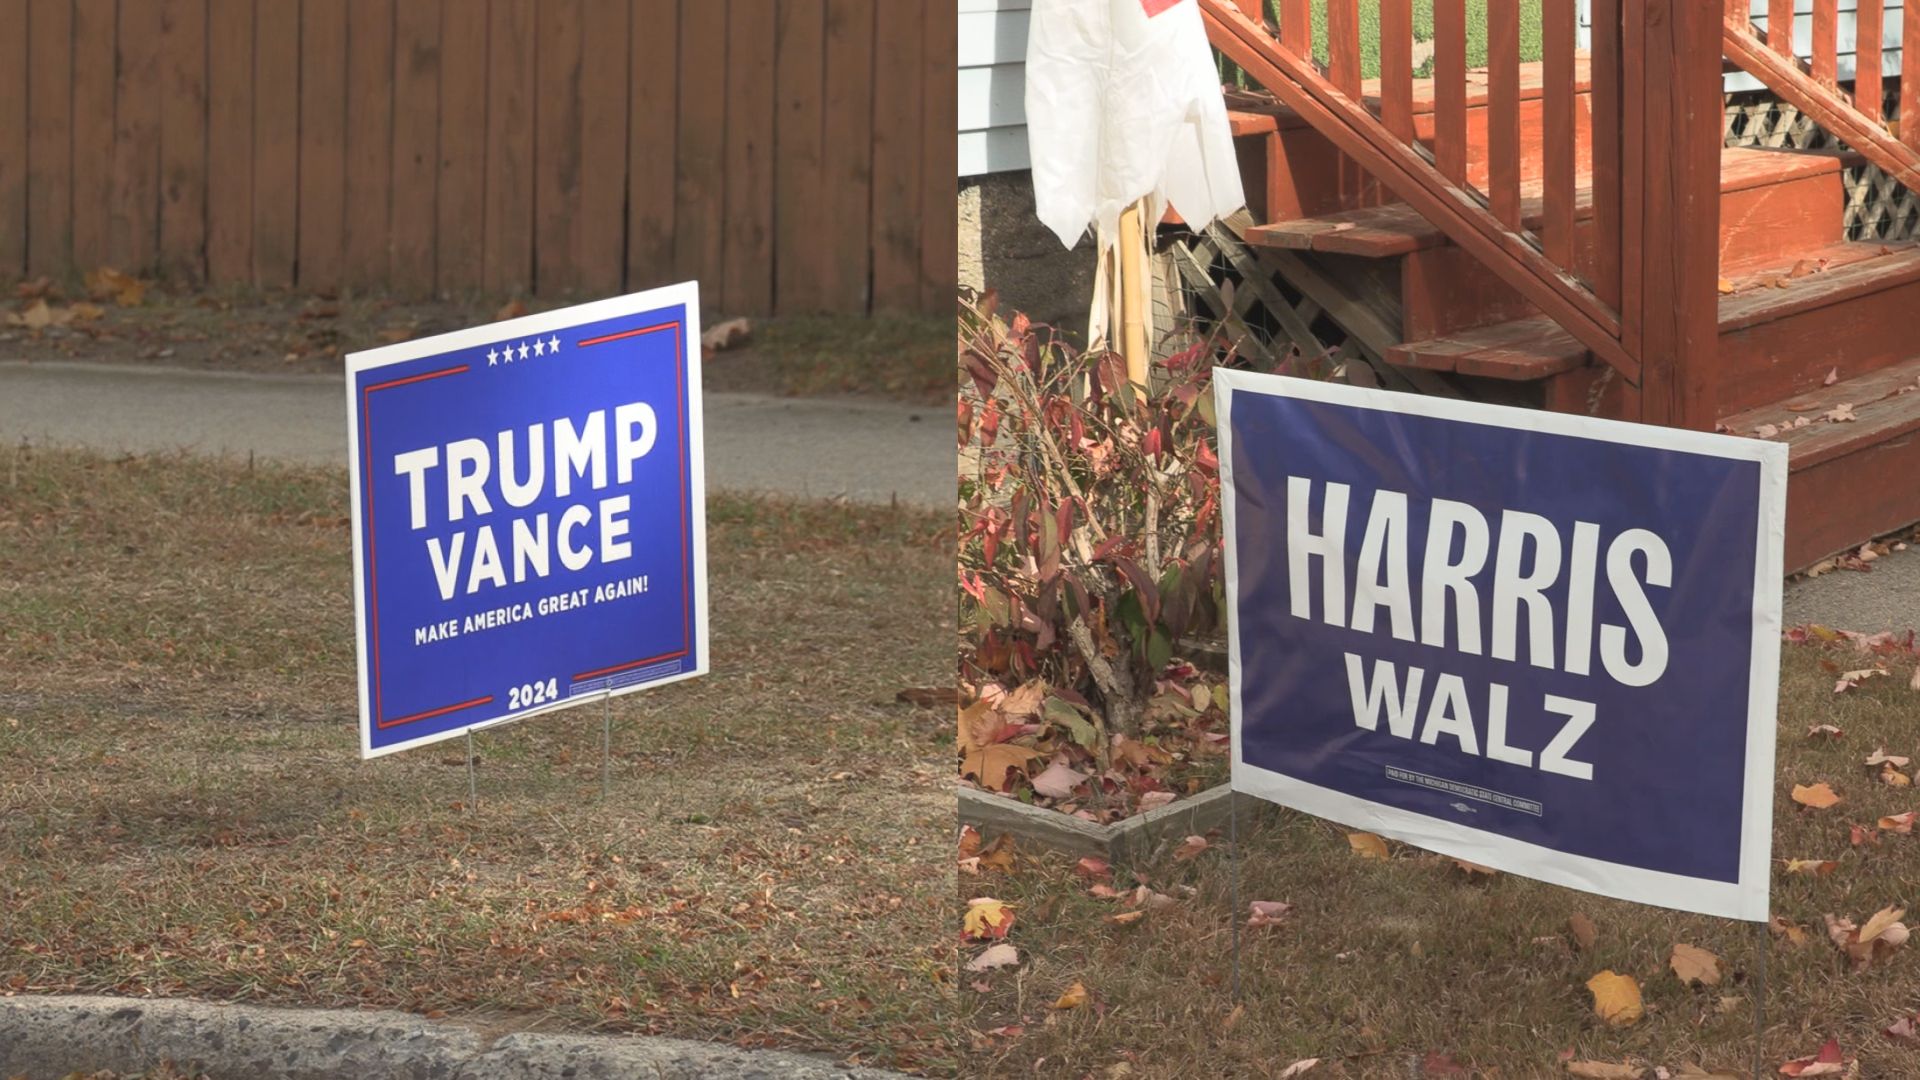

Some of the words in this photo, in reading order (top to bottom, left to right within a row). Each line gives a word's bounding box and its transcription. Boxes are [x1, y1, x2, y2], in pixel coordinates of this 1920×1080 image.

[394, 401, 657, 530] TRUMP
[426, 494, 632, 601] VANCE
[1287, 475, 1672, 687] HARRIS
[415, 618, 458, 645] MAKE
[463, 603, 533, 634] AMERICA
[538, 588, 589, 616] GREAT
[595, 575, 649, 604] AGAIN!
[508, 679, 558, 710] 2024
[1345, 652, 1597, 780] WALZ
[1387, 768, 1398, 777] PAID
[1398, 771, 1408, 780] FOR
[1409, 773, 1415, 782] BY
[1416, 775, 1424, 784] THE
[1425, 778, 1449, 789] MICHIGAN
[1449, 783, 1478, 796] DEMOCRATIC
[1479, 790, 1492, 801] STATE
[1493, 793, 1512, 806] CENTRAL
[1513, 798, 1540, 813] COMMITTEE
